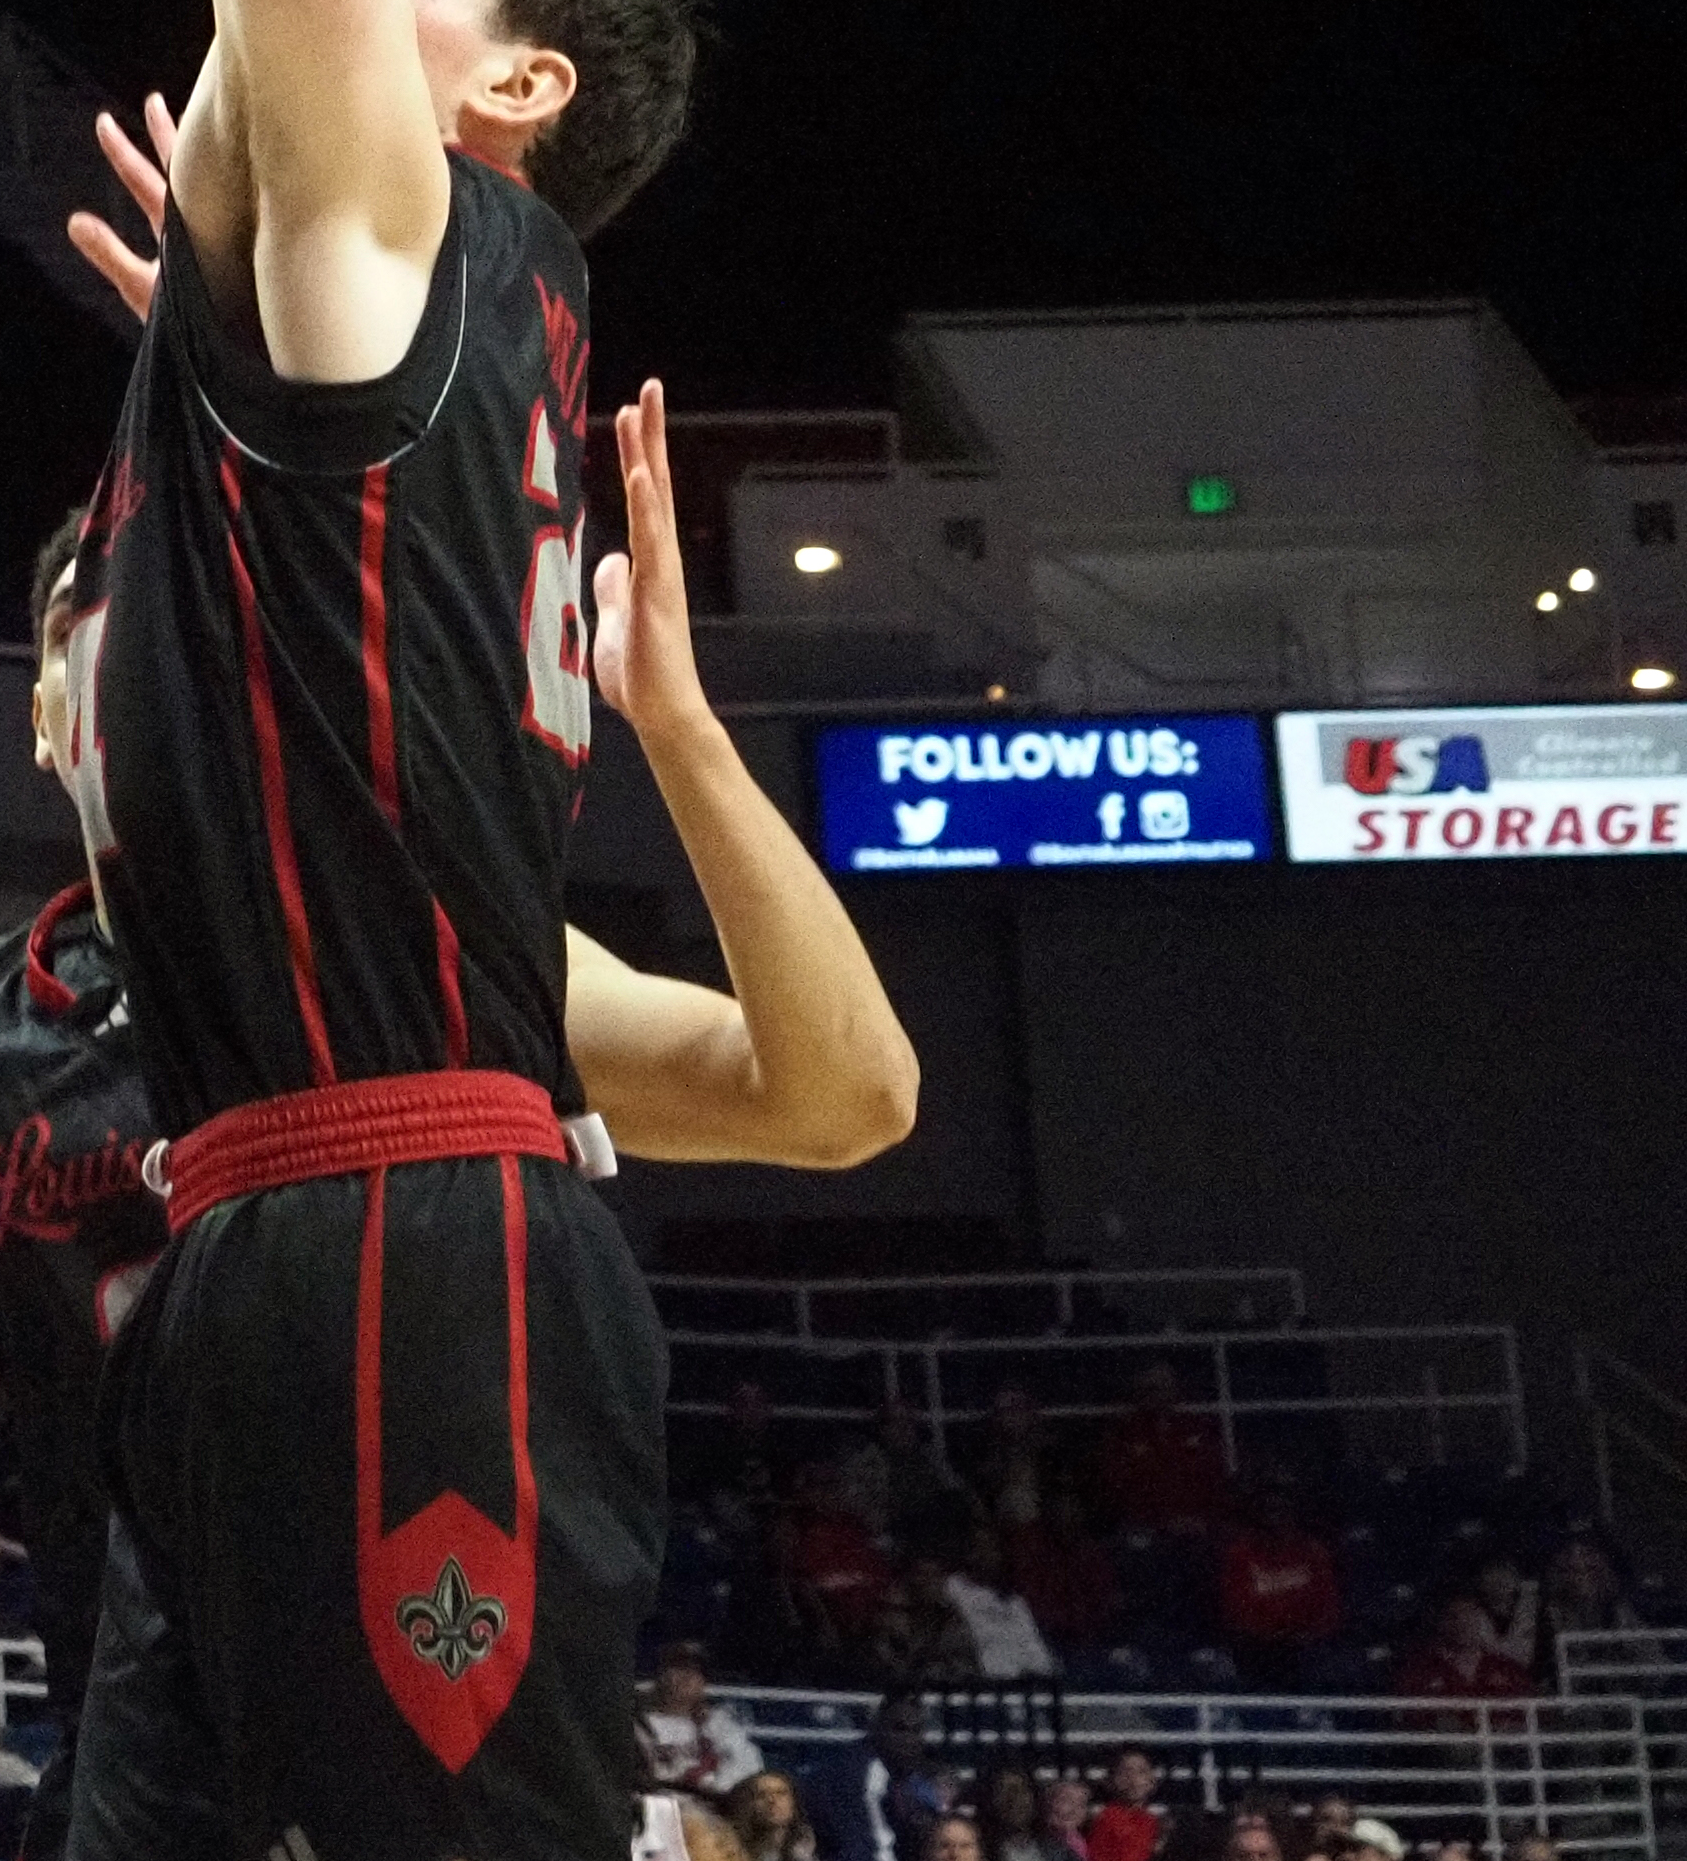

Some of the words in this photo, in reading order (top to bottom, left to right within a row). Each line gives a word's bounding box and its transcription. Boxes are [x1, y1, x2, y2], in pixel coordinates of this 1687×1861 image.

[877, 730, 1102, 783] FOLLOW
[1107, 728, 1200, 778] US:
[1345, 733, 1491, 794] USA
[1354, 803, 1680, 852] STORAGE
